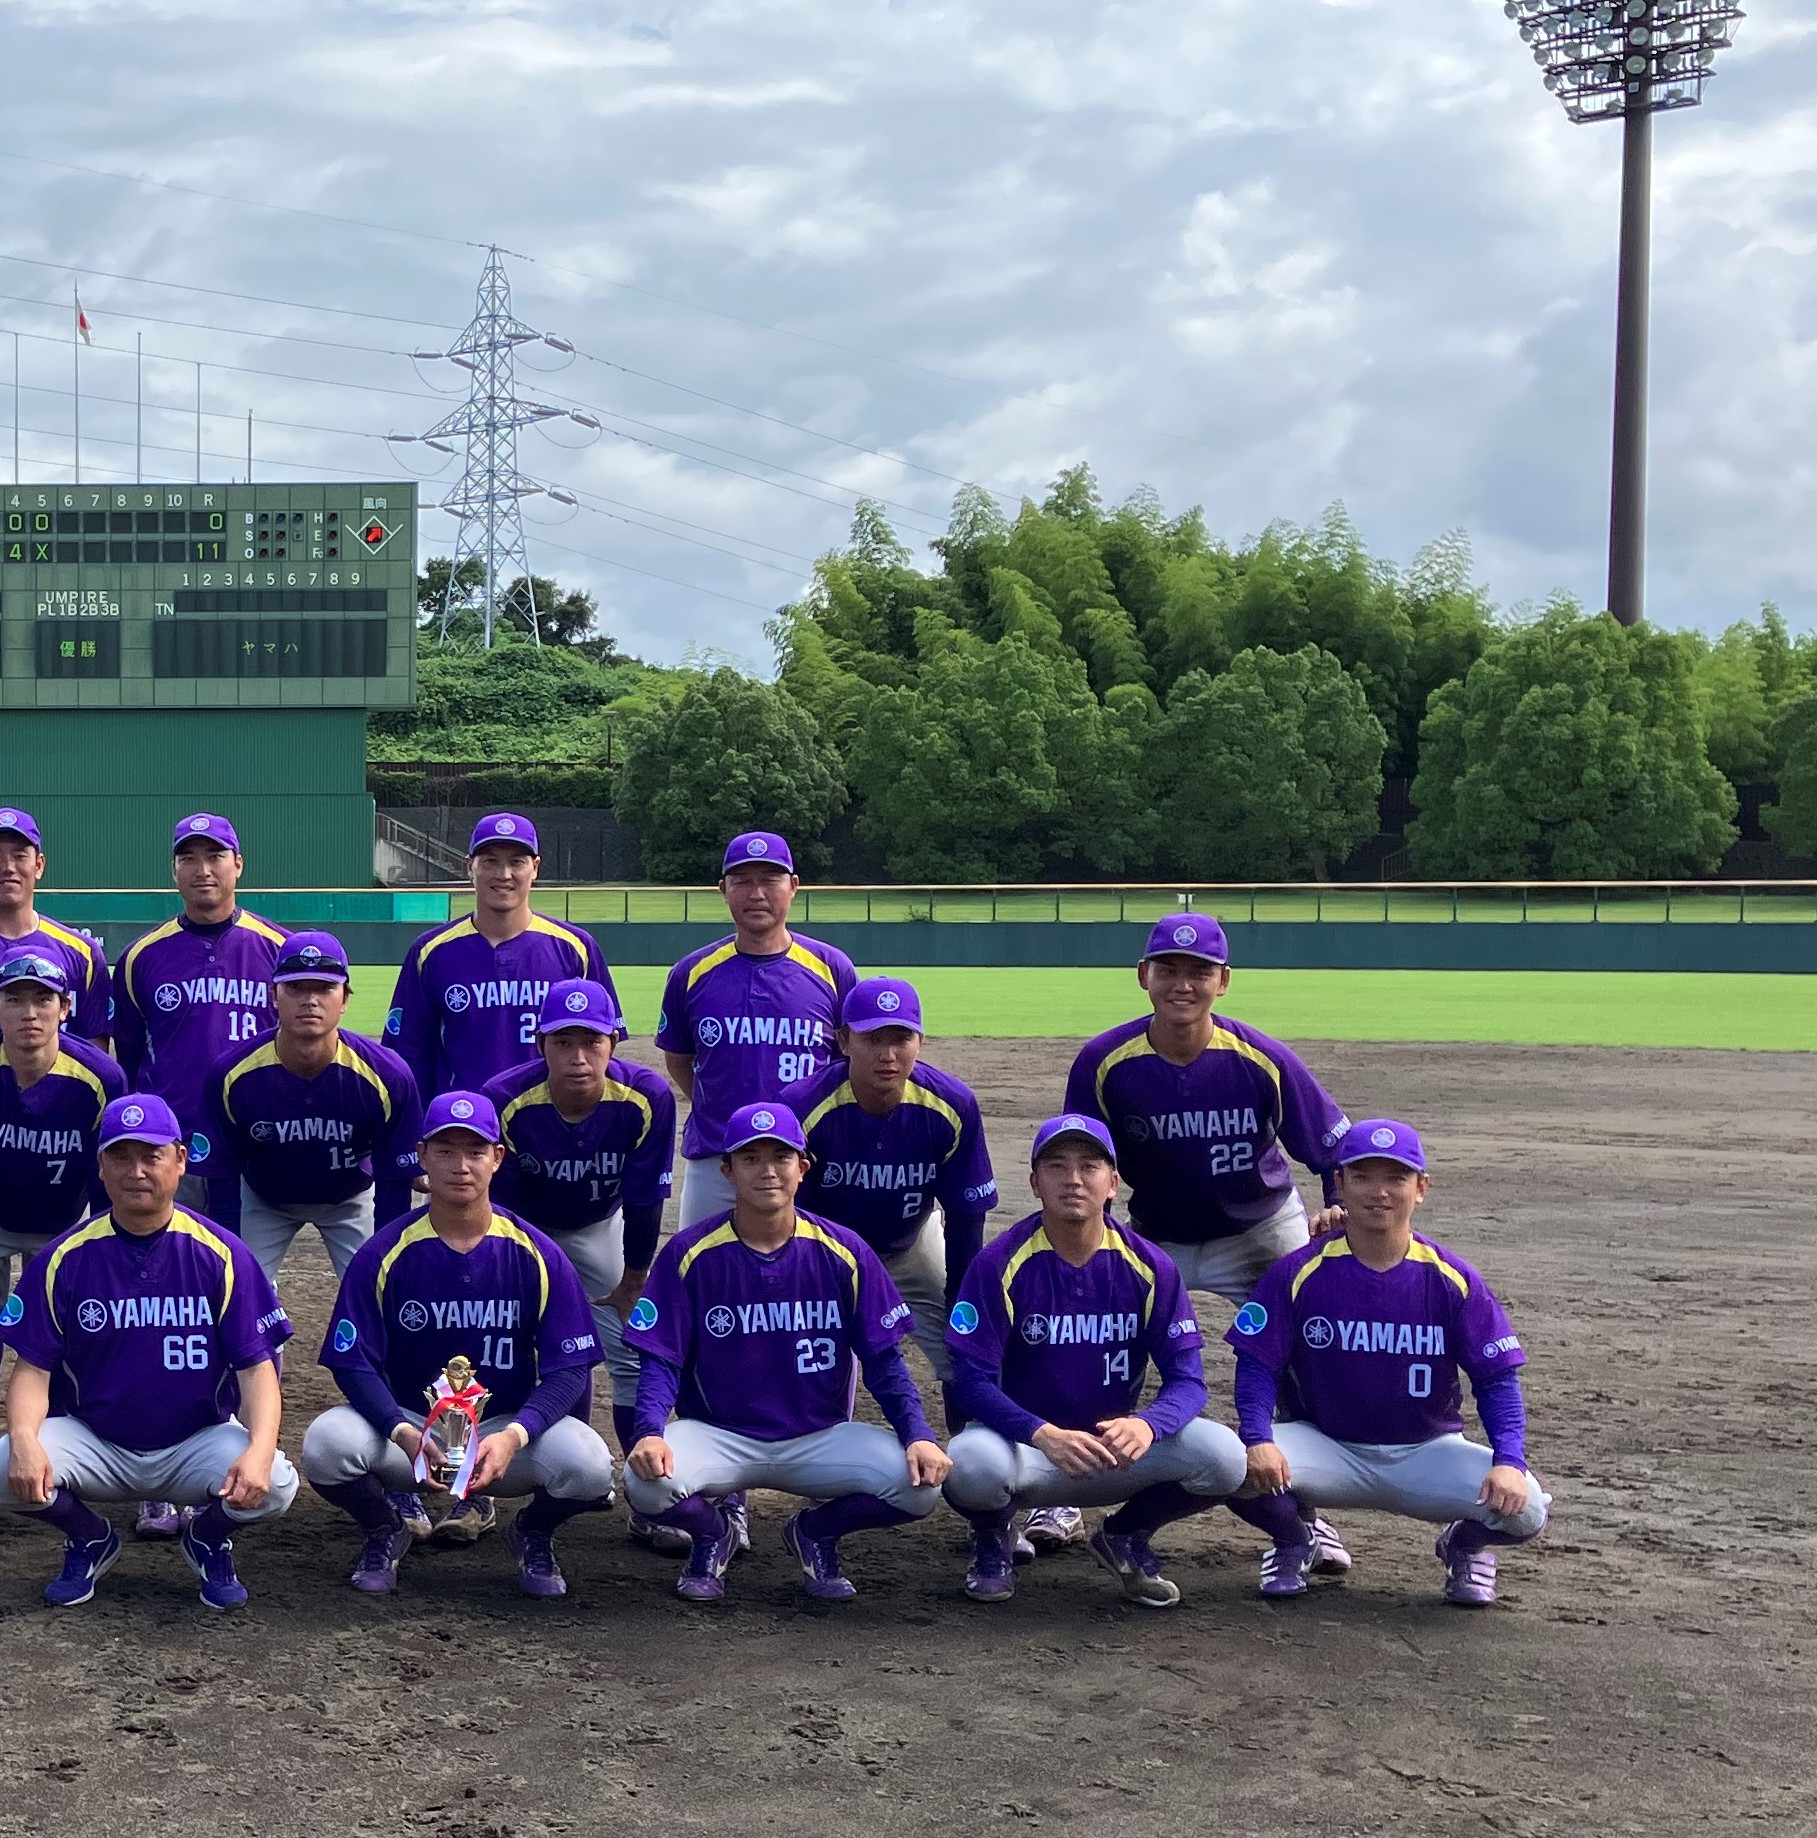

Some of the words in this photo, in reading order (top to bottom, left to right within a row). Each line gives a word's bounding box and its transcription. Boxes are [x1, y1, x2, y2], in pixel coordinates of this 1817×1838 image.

[10, 494, 22, 507] 4
[37, 494, 48, 507] 5
[63, 494, 74, 507] 6
[90, 494, 101, 507] 7
[116, 494, 128, 507] 8
[143, 494, 154, 507] 9
[168, 494, 183, 507] 10
[204, 494, 214, 507] R
[9, 514, 22, 531] 0
[35, 514, 49, 531] 0
[210, 513, 223, 530] 0
[245, 513, 254, 525] B
[314, 512, 324, 525] H
[245, 530, 254, 542] S
[315, 530, 323, 542] E
[9, 543, 22, 560] 4
[36, 543, 49, 560] X
[197, 542, 219, 560] 11
[182, 573, 190, 586] 1
[203, 573, 213, 586] 2
[224, 573, 234, 586] 3
[244, 573, 255, 586] 4
[266, 573, 276, 586] 5
[287, 573, 297, 586] 6
[309, 573, 318, 586] 7
[329, 573, 340, 586] 8
[351, 573, 361, 586] 9
[45, 590, 108, 603] UMPIRE
[155, 603, 174, 616] TN
[60, 641, 96, 657] 優勝
[242, 640, 299, 655] ヤマハ
[181, 977, 267, 1008] YAMAHA
[471, 980, 548, 1008] YAMAH
[723, 1016, 823, 1047] YAMAHA
[778, 1052, 814, 1082] 80
[275, 1117, 353, 1144] YAMAH
[1149, 1107, 1258, 1140] YAMAHA
[46, 1158, 67, 1185] 7
[1210, 1141, 1254, 1176] 22
[842, 1162, 935, 1190] YAMAHA
[903, 1191, 922, 1219] 2
[109, 1295, 213, 1329] YAMAHA
[430, 1299, 521, 1329] YAMAHA
[737, 1300, 842, 1334] YAMAHA
[1047, 1312, 1137, 1344] YAMAHA
[1337, 1320, 1445, 1355] YAMAHA
[162, 1334, 208, 1370] 66
[479, 1334, 514, 1370] 10
[796, 1337, 836, 1374] 23
[1103, 1349, 1129, 1386] 14
[1408, 1363, 1431, 1398] 0
